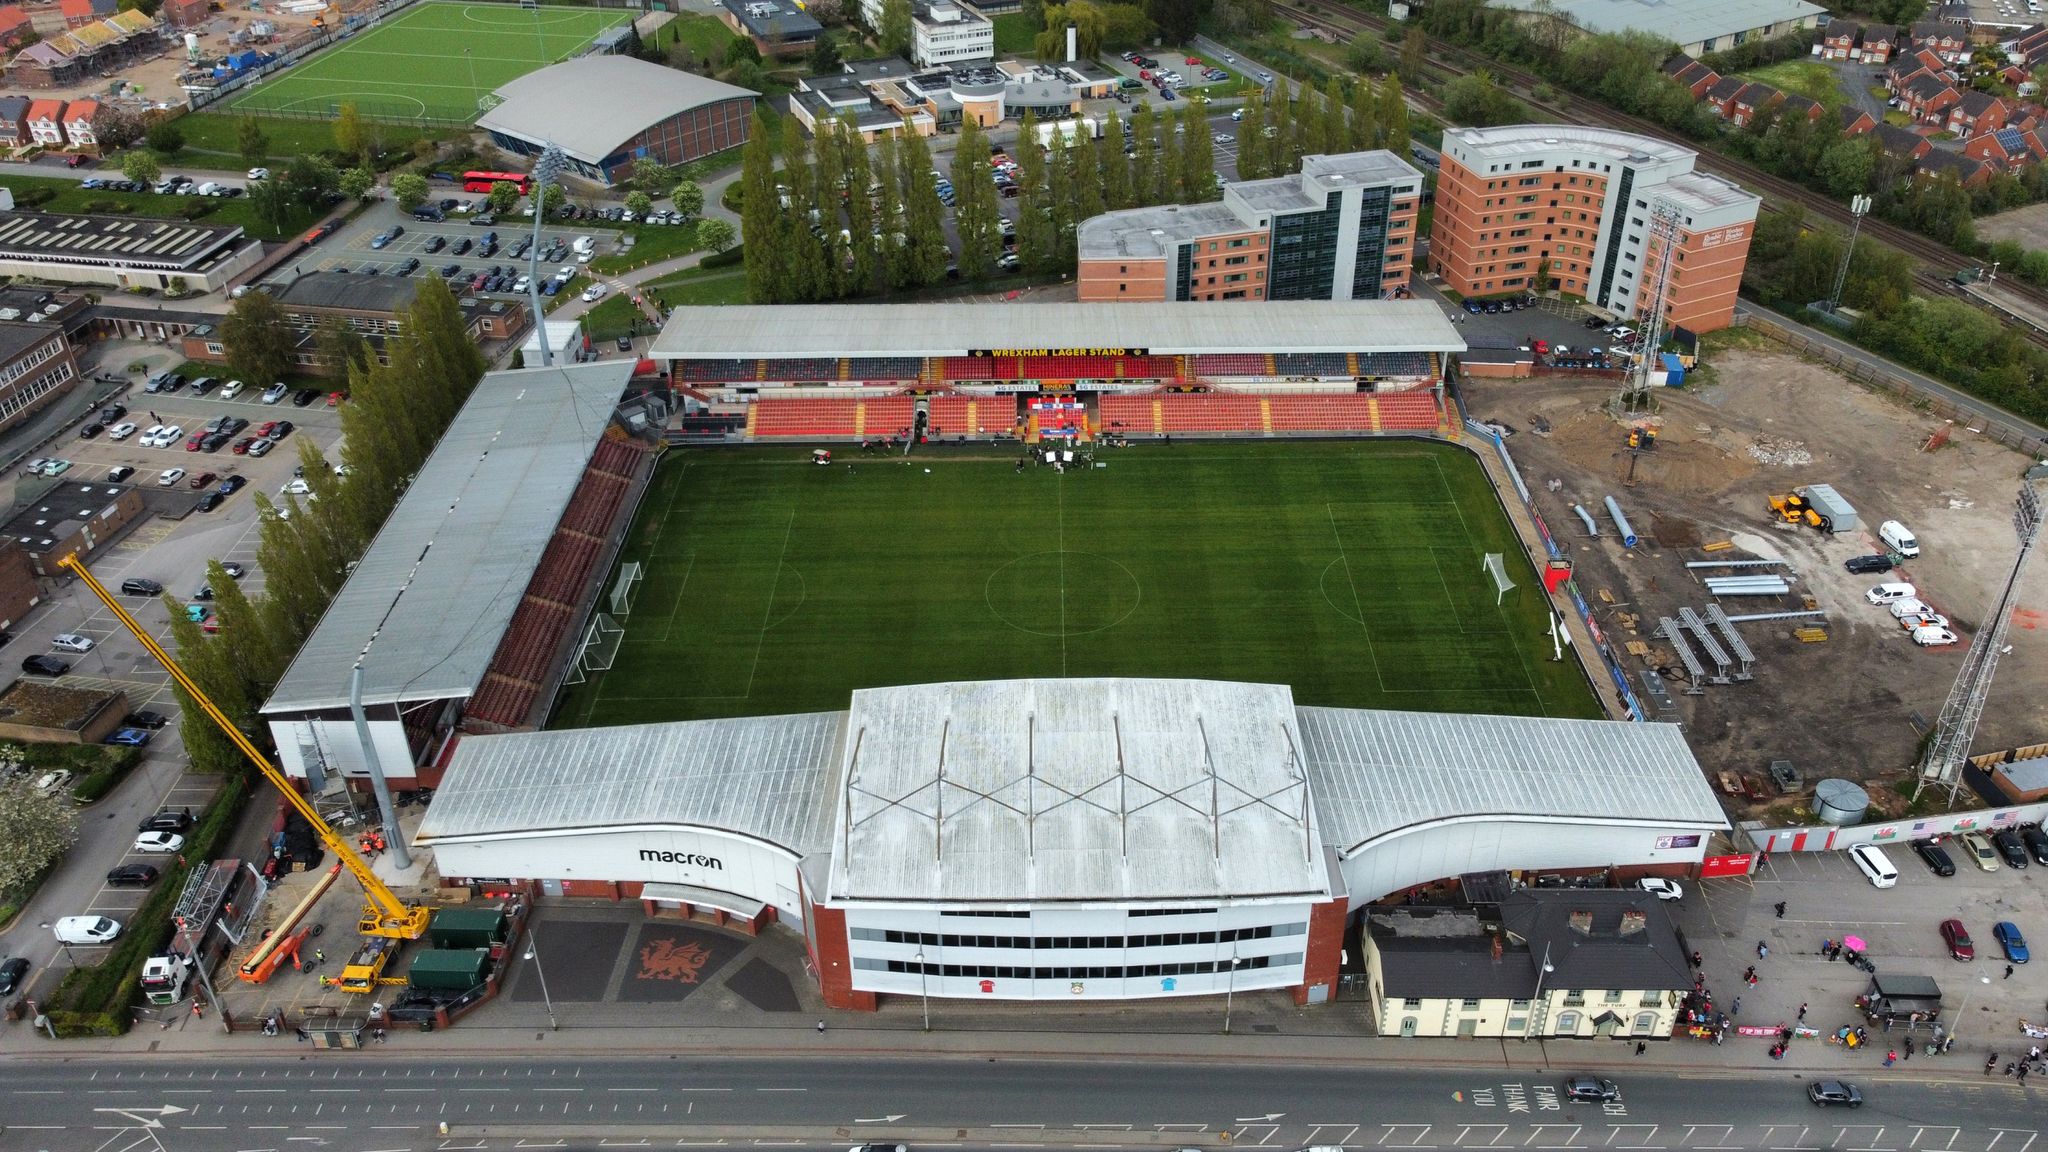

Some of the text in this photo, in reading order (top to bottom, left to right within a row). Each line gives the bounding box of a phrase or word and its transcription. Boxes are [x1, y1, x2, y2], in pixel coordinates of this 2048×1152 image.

[991, 348, 1126, 357] WREXHAM LAGER STAND
[639, 849, 723, 870] macron
[1471, 1088, 1497, 1107] YOU
[1501, 1082, 1530, 1113] THANK
[1532, 1085, 1560, 1111] FAWR
